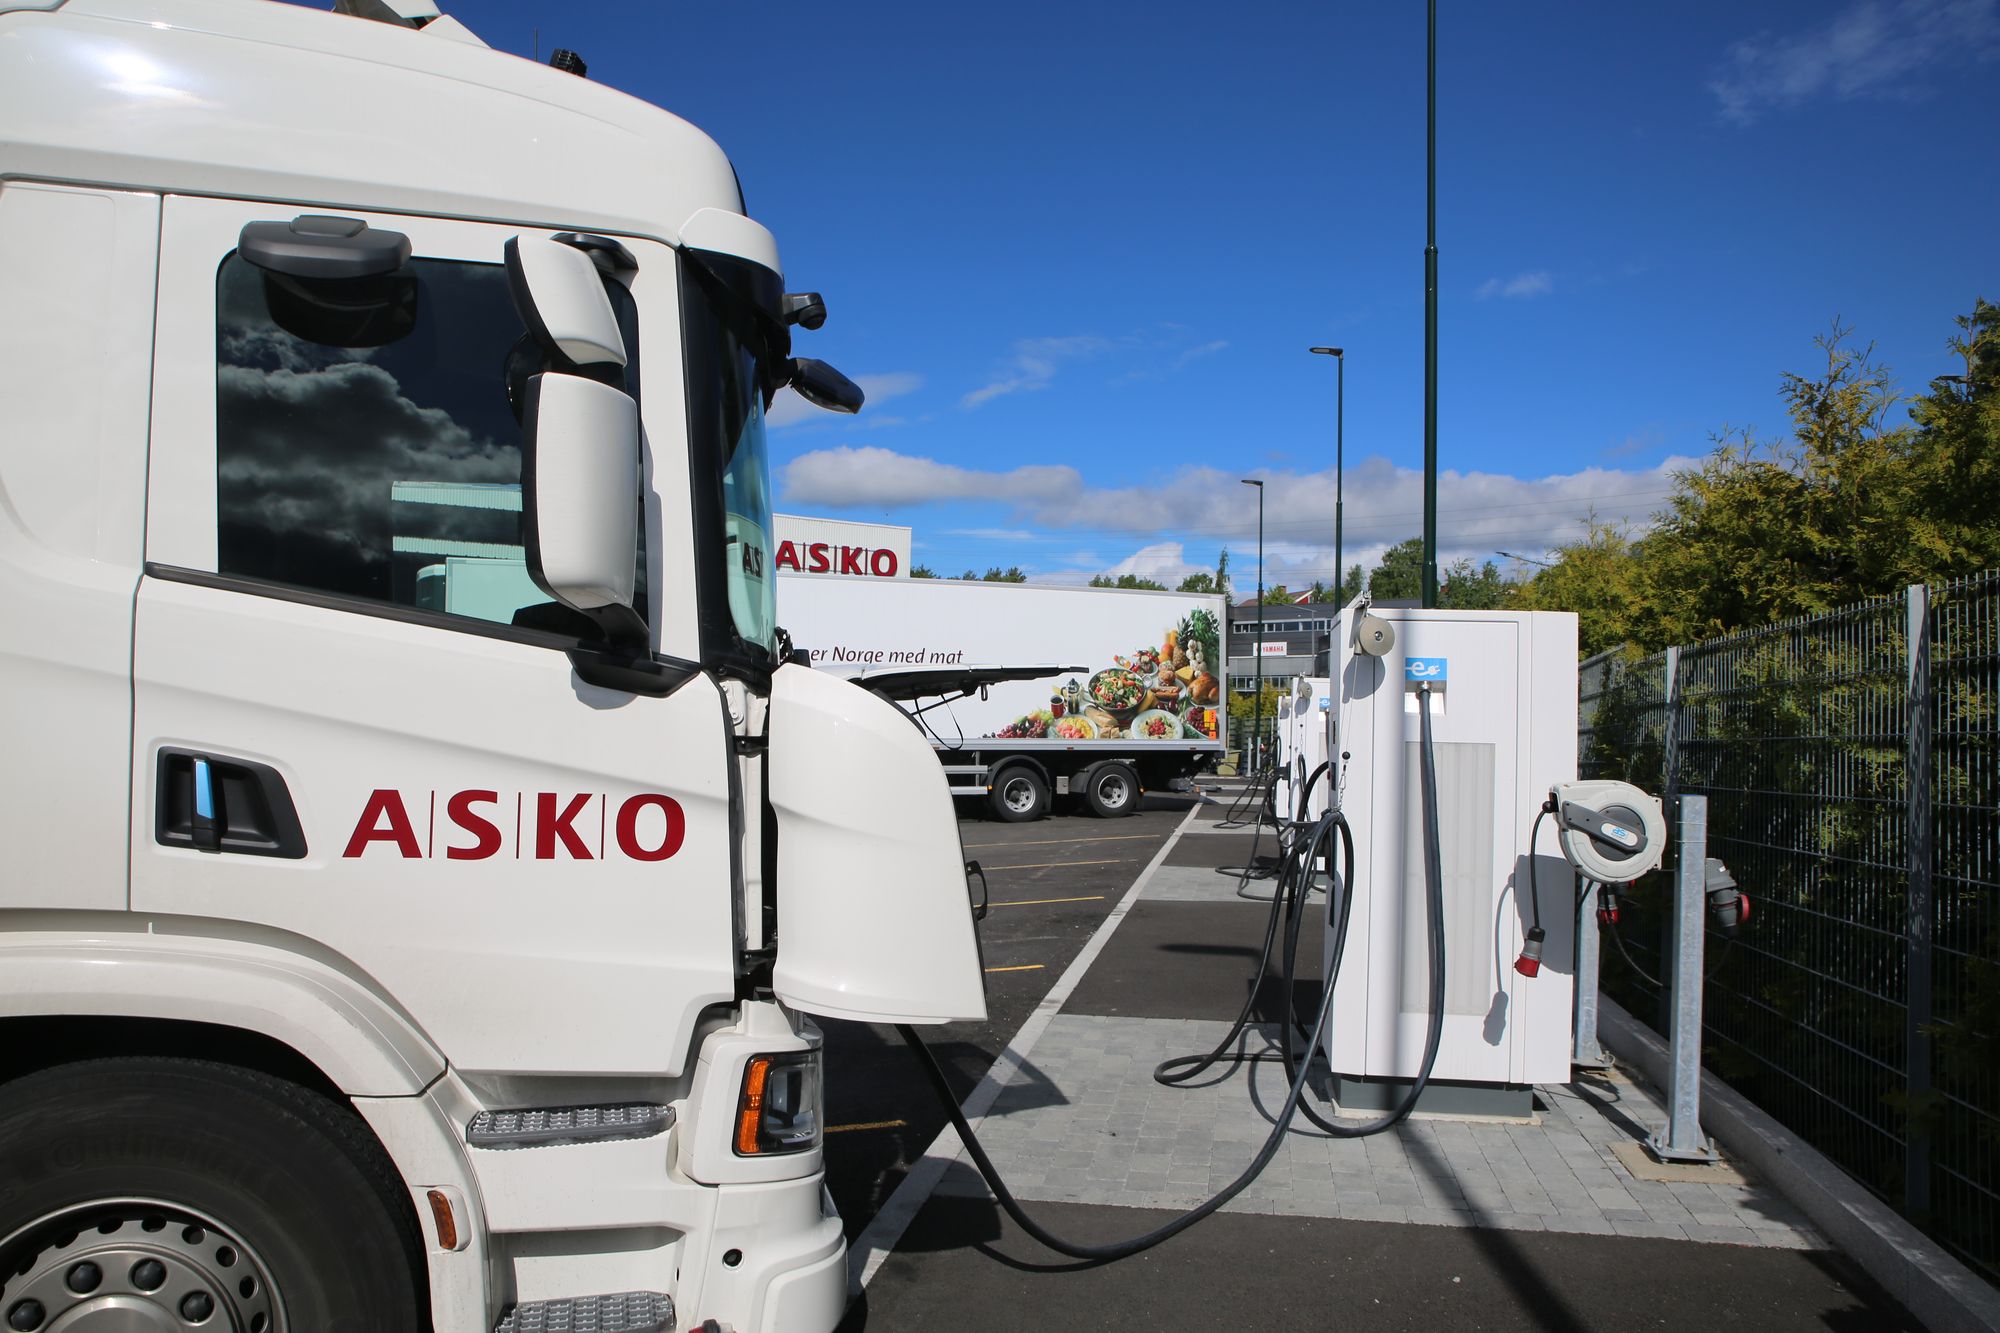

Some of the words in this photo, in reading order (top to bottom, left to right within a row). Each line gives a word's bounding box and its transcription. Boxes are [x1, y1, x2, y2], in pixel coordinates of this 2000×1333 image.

[832, 646, 883, 664] Norge
[888, 648, 926, 663] med
[929, 650, 963, 664] mat
[1262, 645, 1284, 653] YAMAHA
